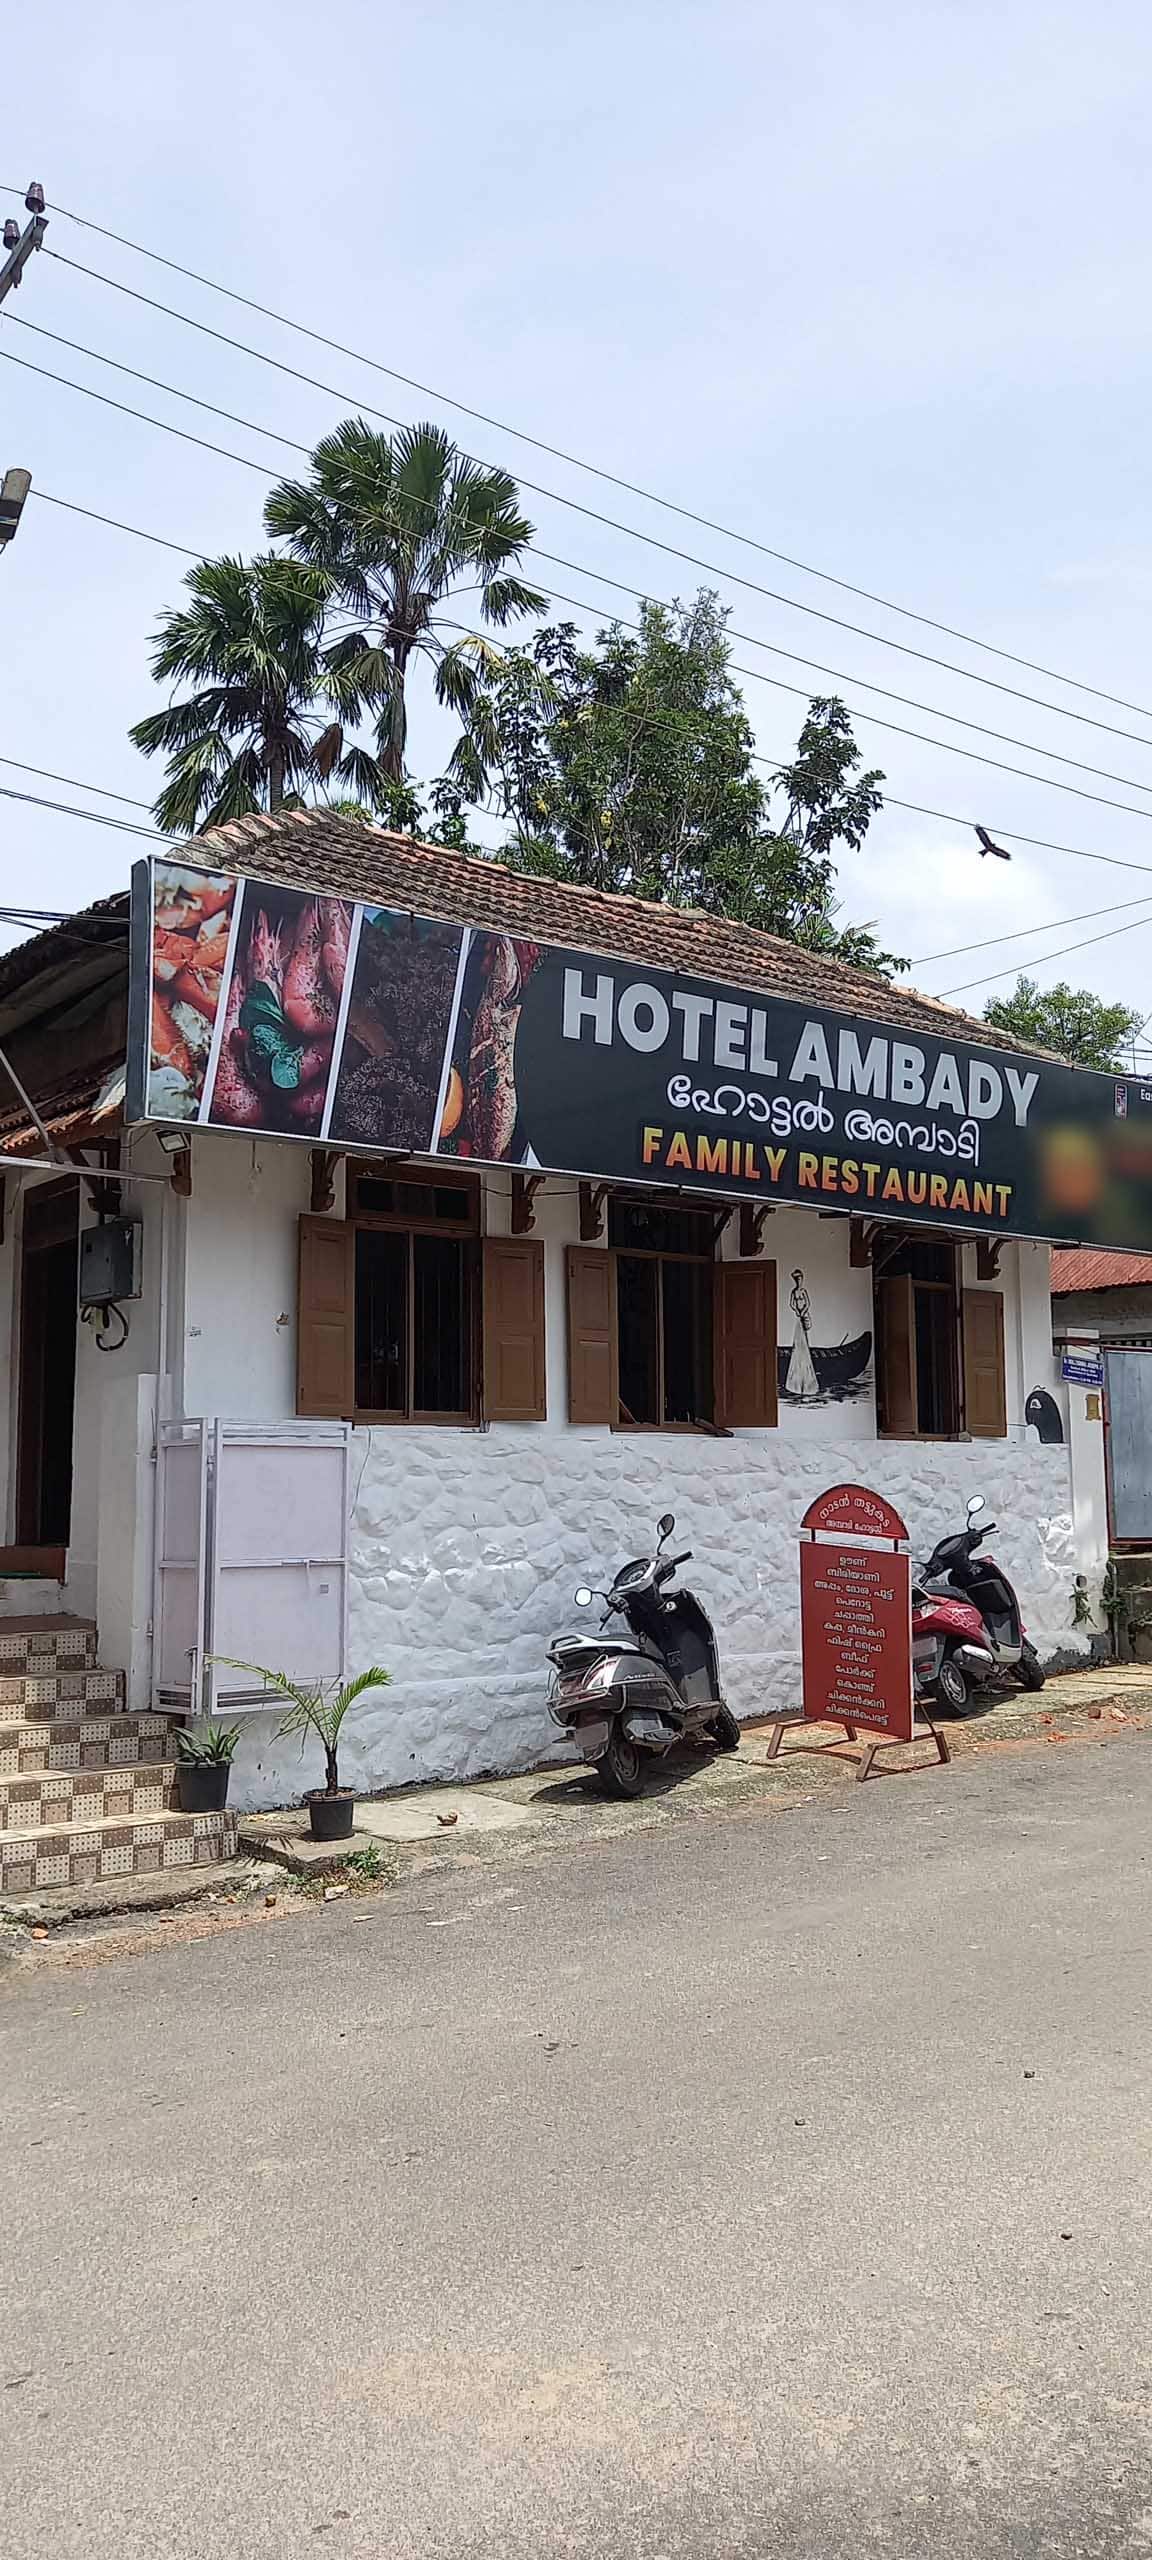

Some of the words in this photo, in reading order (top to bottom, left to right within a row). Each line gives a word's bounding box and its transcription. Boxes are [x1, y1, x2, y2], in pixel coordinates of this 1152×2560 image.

[563, 968, 778, 1077] HOTEL
[788, 1021, 1040, 1127] AMBADY
[667, 1074, 835, 1137] ഹോട്ടൽ
[844, 1119, 980, 1167] അമ്പാടി
[642, 1126, 788, 1183] FAMILY
[798, 1151, 1013, 1217] RESTAURANT
